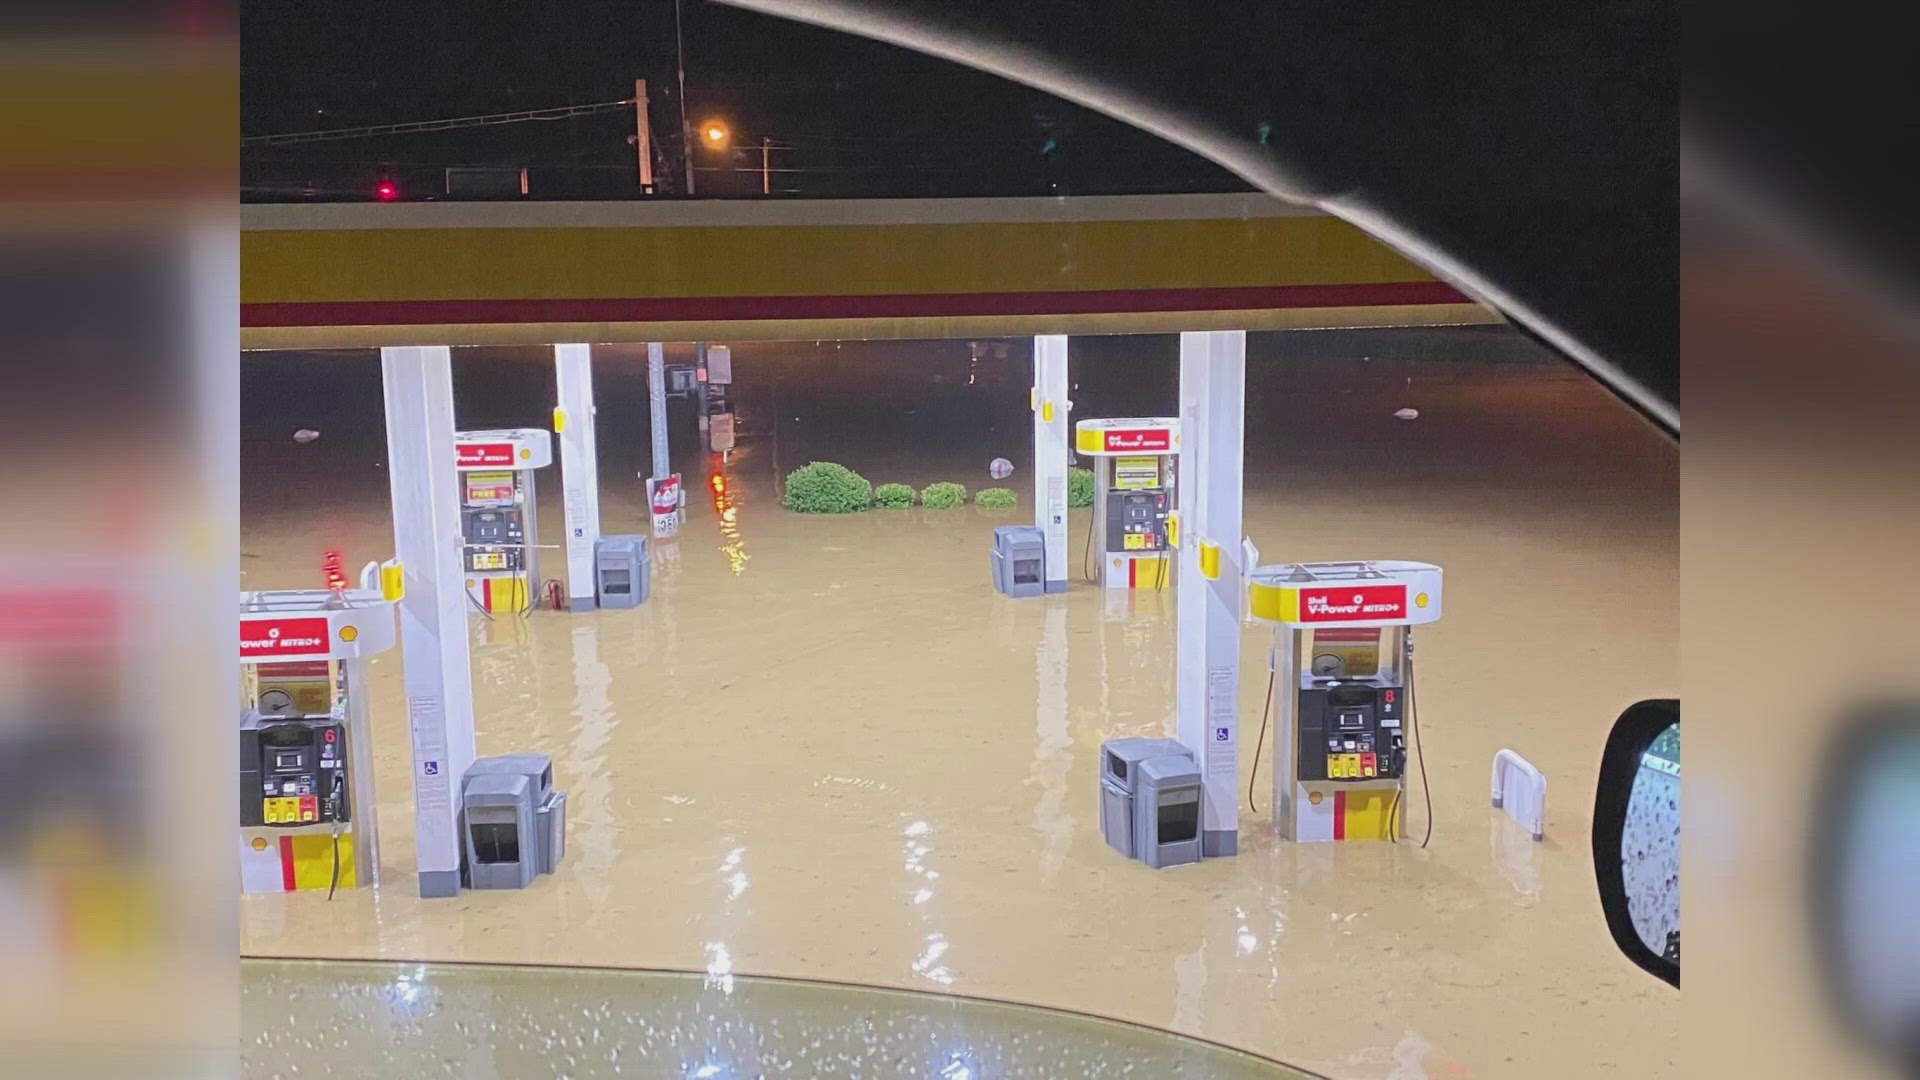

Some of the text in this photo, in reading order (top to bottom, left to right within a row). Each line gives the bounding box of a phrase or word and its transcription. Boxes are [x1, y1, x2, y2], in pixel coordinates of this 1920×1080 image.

[1307, 596, 1328, 604] Shell
[1308, 604, 1399, 614] V-Power NITRO+
[281, 638, 321, 647] NITRO+
[1385, 690, 1395, 703] 8
[325, 729, 336, 743] 6
